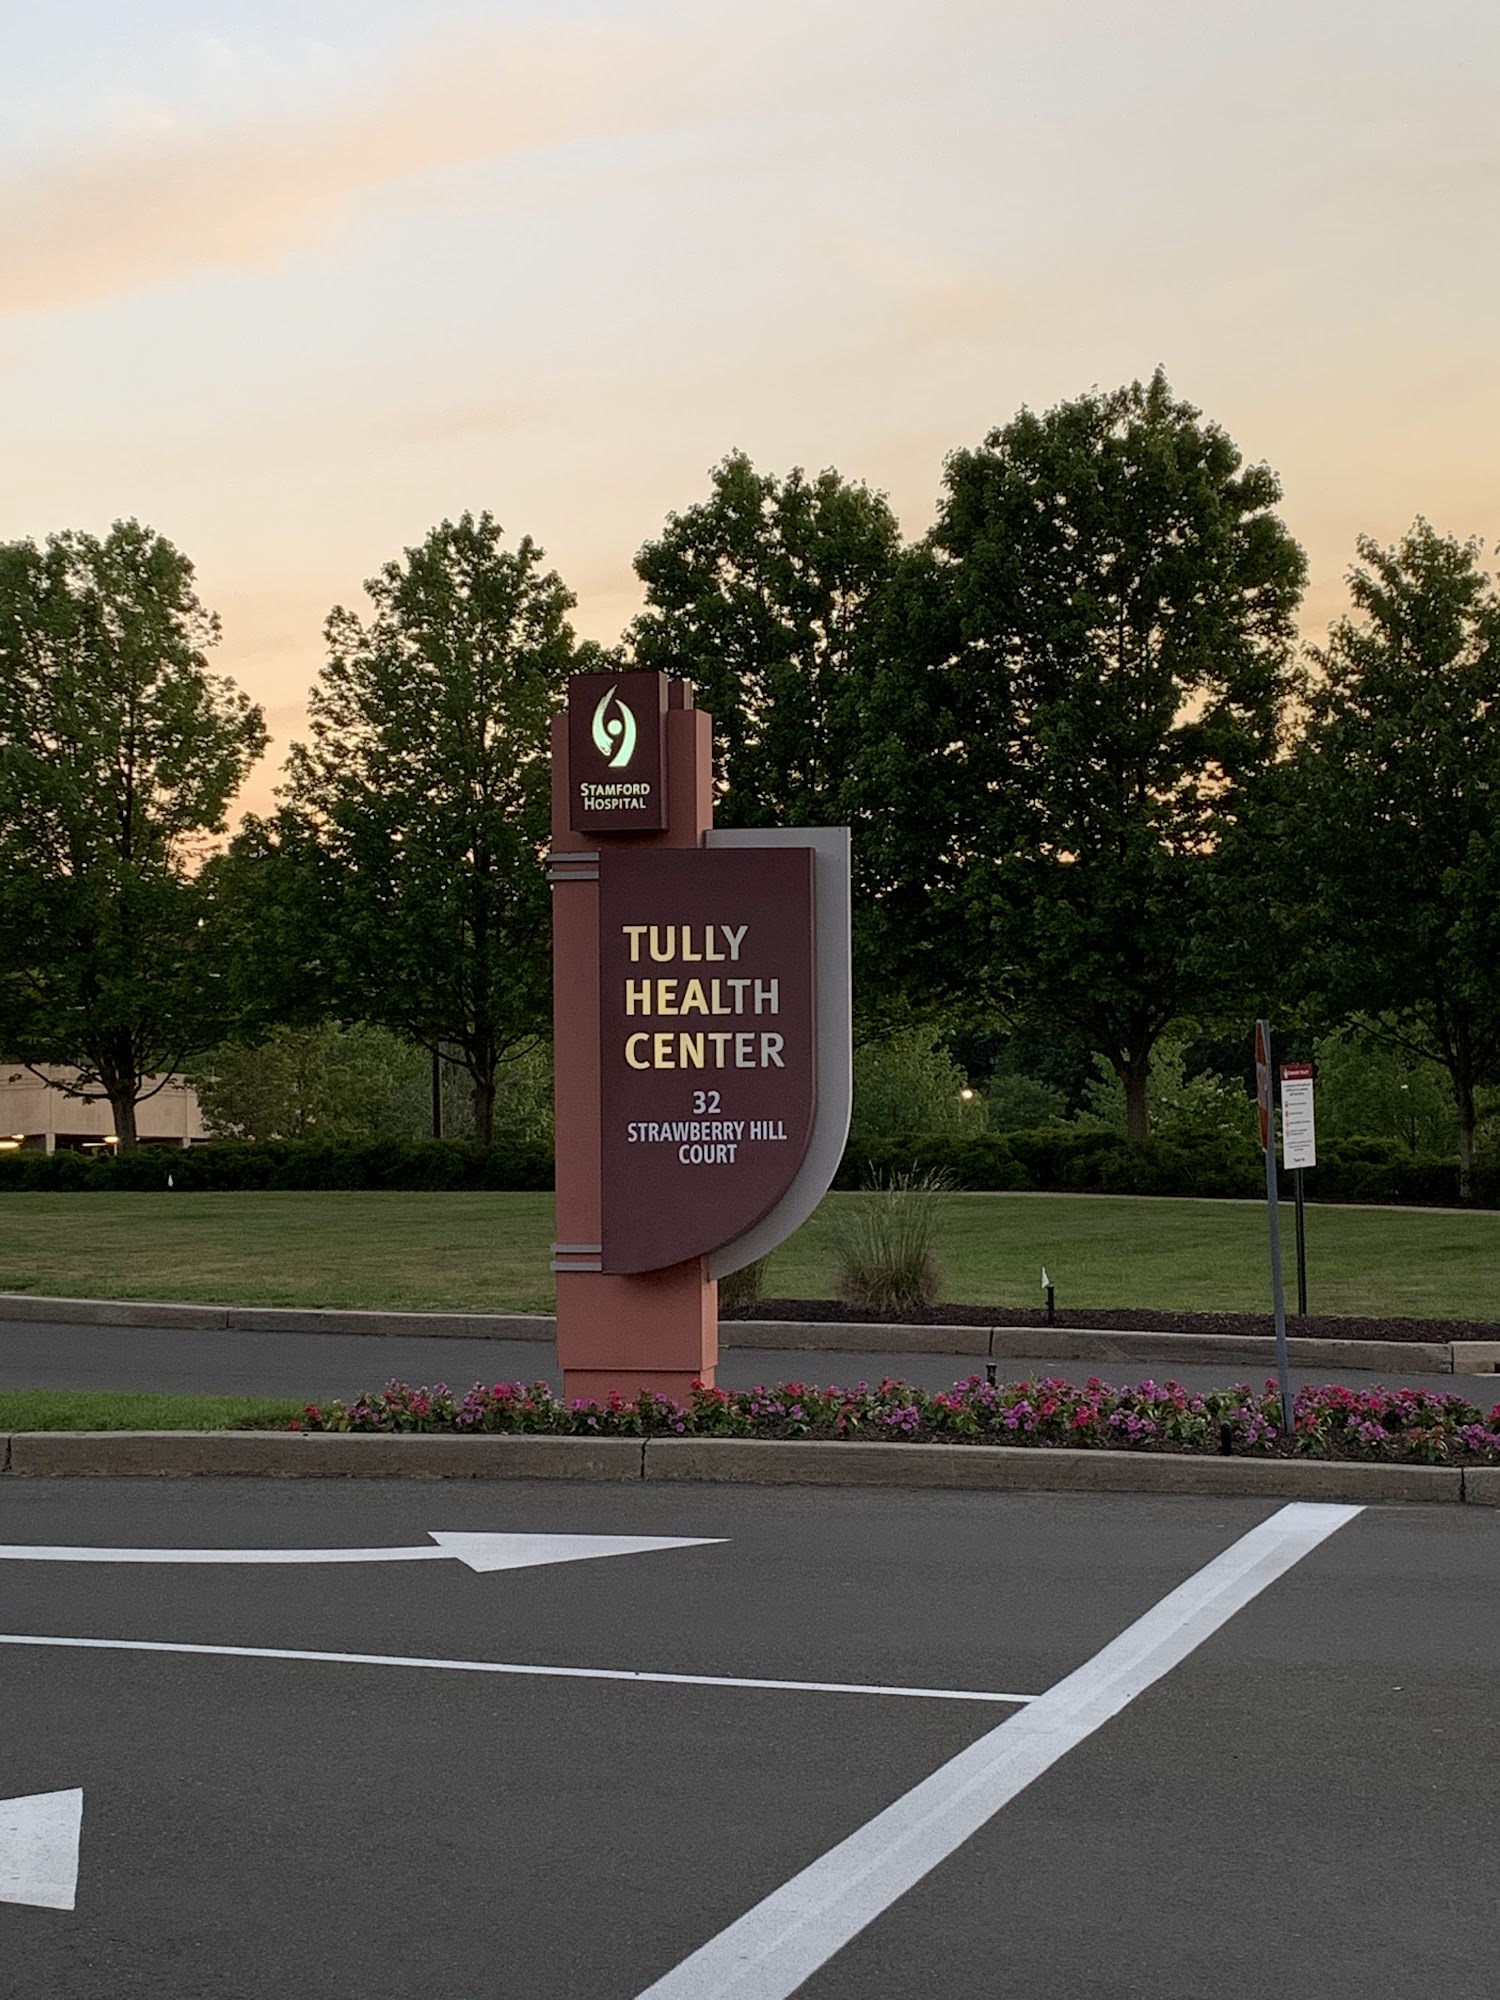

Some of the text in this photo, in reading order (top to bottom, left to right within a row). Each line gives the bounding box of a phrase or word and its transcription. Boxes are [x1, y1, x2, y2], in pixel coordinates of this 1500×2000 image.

[580, 782, 651, 796] STAMFORD
[584, 797, 647, 810] HOSPITAL
[622, 925, 749, 961] TULLY
[625, 979, 779, 1015] HEALTH
[625, 1032, 785, 1069] CENTER
[693, 1090, 721, 1114] 32
[627, 1120, 788, 1142] STRAWBERRY HILL
[678, 1144, 738, 1164] COURT
